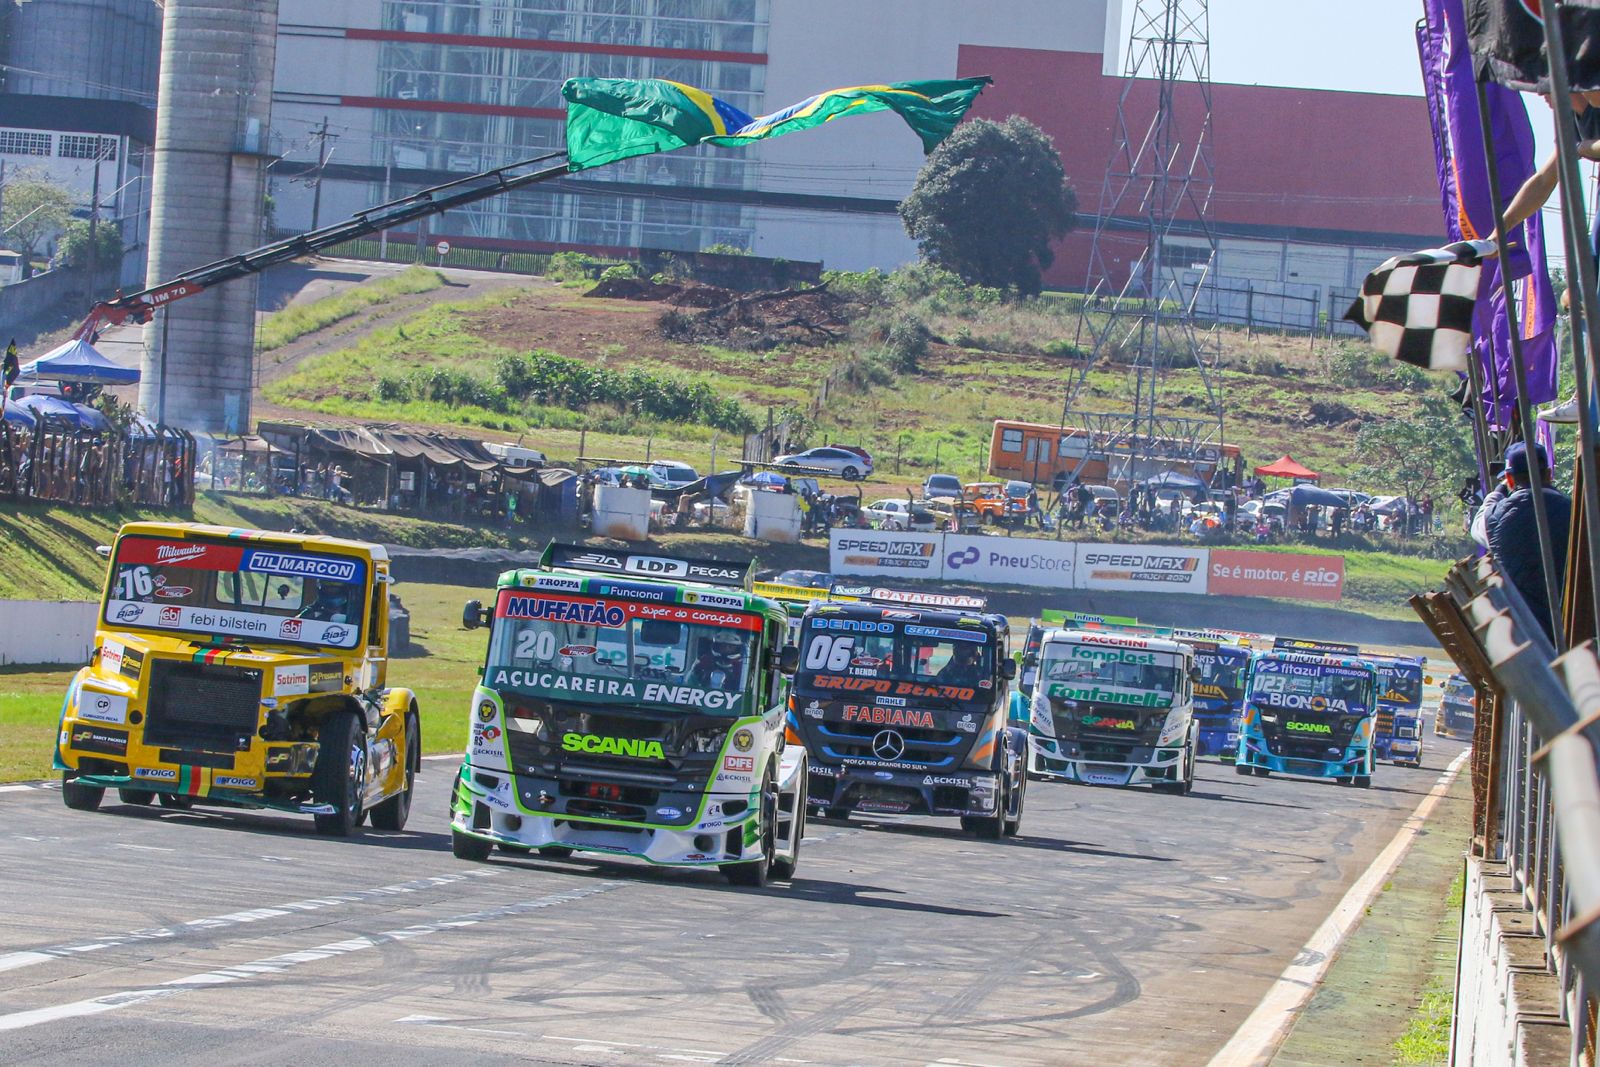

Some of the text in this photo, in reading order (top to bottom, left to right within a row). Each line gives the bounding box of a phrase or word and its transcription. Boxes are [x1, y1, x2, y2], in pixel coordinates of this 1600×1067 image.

[156, 544, 206, 559] Milwaukee
[281, 558, 351, 577] MARCON
[990, 552, 1071, 571] PneuStore
[636, 560, 739, 579] LDP PEÇAS
[1213, 563, 1230, 577] Se
[1233, 565, 1241, 578] é
[1292, 569, 1300, 581] é
[119, 566, 152, 599] 76
[538, 578, 580, 589] TROPPA
[611, 587, 663, 600] Funcional
[701, 595, 743, 607] TROPPA
[116, 606, 144, 619] Biasi
[506, 597, 625, 627] MUFFATÃO
[675, 608, 688, 618] do
[692, 612, 742, 624] coração
[191, 613, 267, 632] febi bilstein
[812, 618, 894, 633] BENDO
[321, 628, 349, 640] Biasi
[1081, 635, 1148, 648] FACCHINI
[515, 630, 556, 660] 20
[806, 635, 855, 671] 06
[1071, 646, 1156, 665] fonplast
[1194, 654, 1216, 664] ARTS
[855, 667, 877, 676] BENDO
[1280, 663, 1320, 677] fitazul
[1325, 667, 1369, 678] DISTRIBUIDORA
[494, 670, 742, 710] AÇUCAREIRA ENERGY
[814, 675, 891, 693] GRUPO
[877, 697, 904, 706] MAHLE
[1048, 683, 1173, 707] Fontanella
[1270, 693, 1348, 713] BIONOVA
[847, 705, 934, 728] FABIANA
[1081, 715, 1136, 730] SCANIA
[1286, 721, 1331, 734] SCANIA
[562, 732, 666, 760] SCANIA
[145, 769, 176, 777] TOIGO
[226, 777, 256, 786] TOIGO
